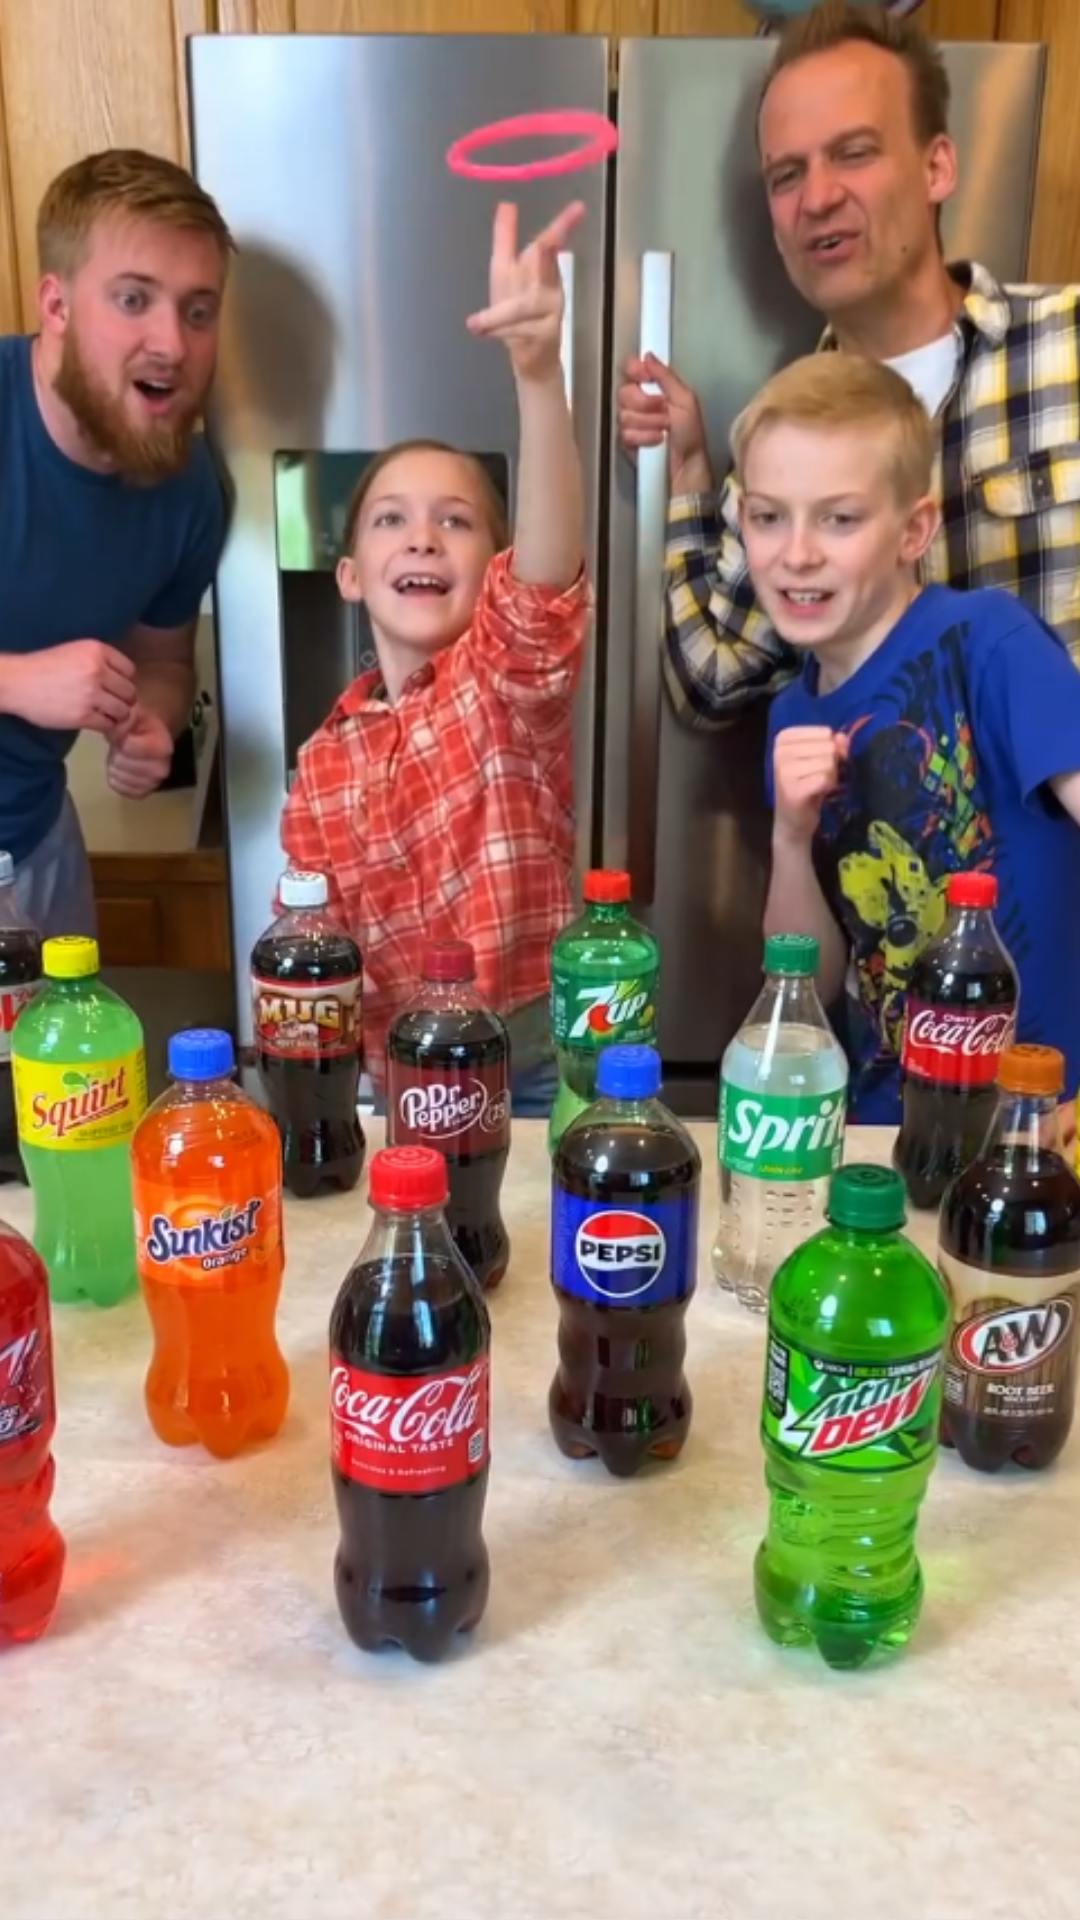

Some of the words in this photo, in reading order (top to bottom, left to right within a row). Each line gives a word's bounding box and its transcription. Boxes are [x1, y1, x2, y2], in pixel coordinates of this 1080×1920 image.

[259, 997, 340, 1029] MUG
[943, 1012, 977, 1024] Cherry
[32, 1066, 127, 1137] Squirt
[400, 1086, 481, 1133] Pepper
[427, 1083, 462, 1108] Dr
[146, 1198, 261, 1264] Sunkist
[201, 1247, 248, 1270] Orange
[579, 1239, 662, 1263] PEPSI
[979, 1303, 1056, 1366] A&W
[331, 1364, 481, 1442] Coca-Cola
[986, 1382, 1022, 1396] ROOT
[1026, 1383, 1055, 1396] BEER
[344, 1430, 406, 1454] ORIGINAL
[411, 1438, 454, 1454] TASTE
